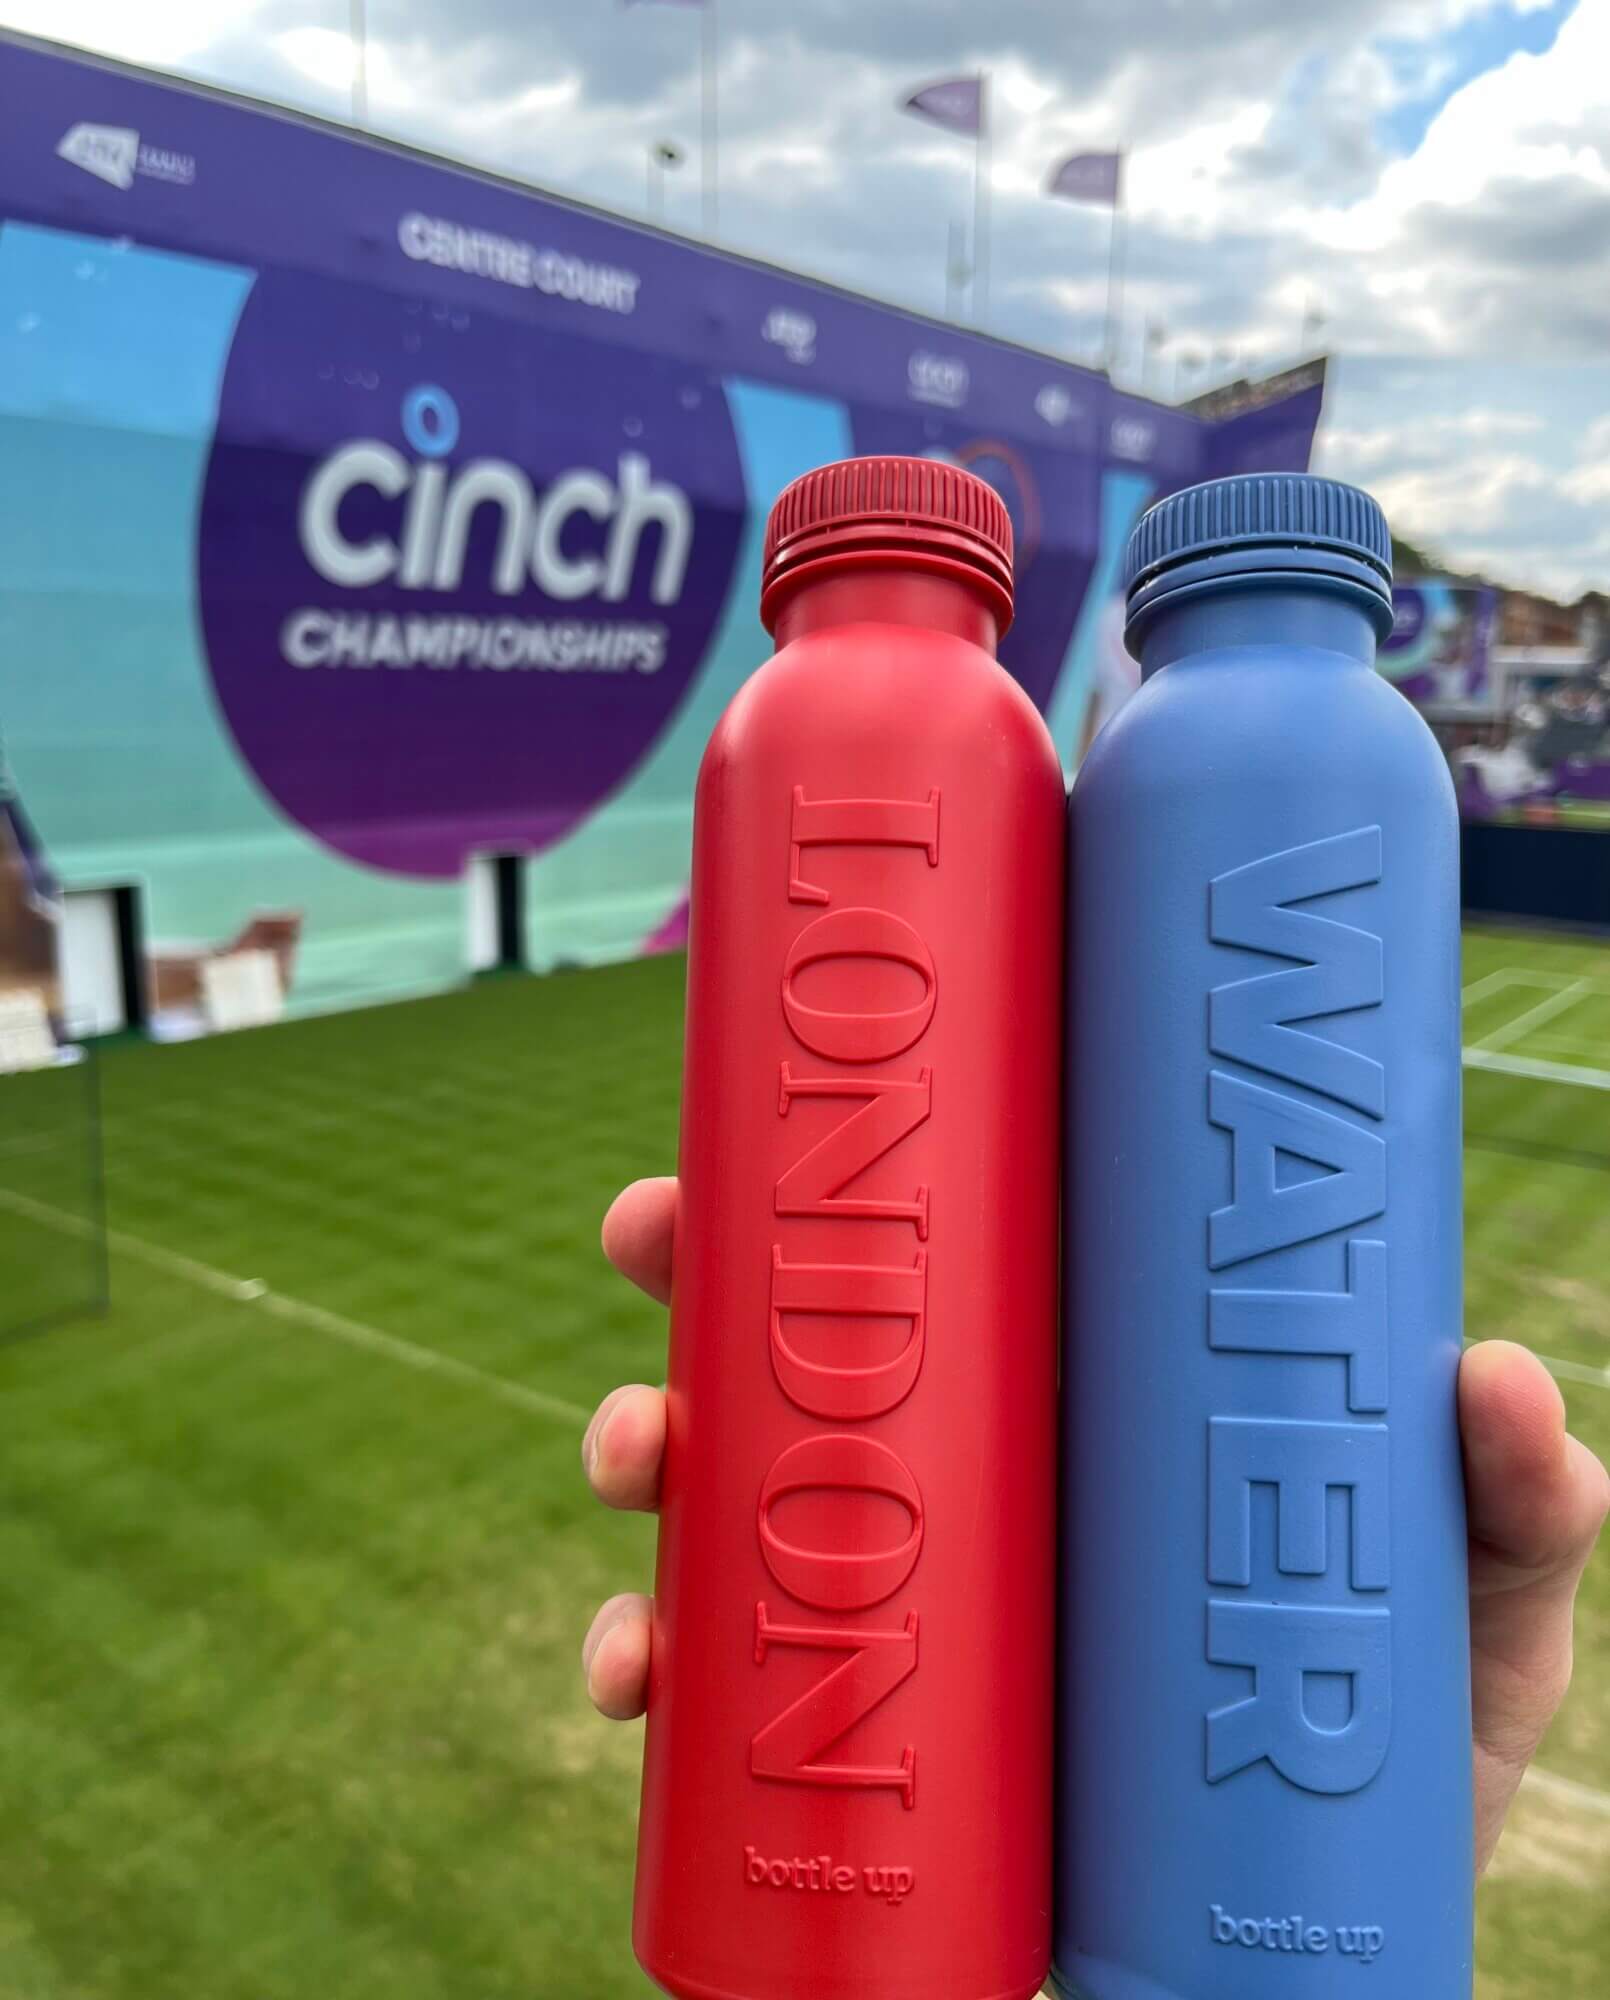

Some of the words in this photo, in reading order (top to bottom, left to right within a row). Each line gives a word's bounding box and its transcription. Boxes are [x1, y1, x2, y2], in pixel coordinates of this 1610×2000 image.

[398, 213, 535, 288] CENTRE
[534, 252, 640, 314] COURT
[302, 384, 692, 605] cinch
[281, 607, 667, 673] CHAMPIONSHIPS
[751, 784, 941, 1811] LONDON
[1205, 824, 1391, 1796] WATER
[744, 1845, 857, 1893] bottle
[862, 1866, 915, 1906] up
[1208, 1903, 1329, 1953] bottle
[1335, 1925, 1385, 1964] up
